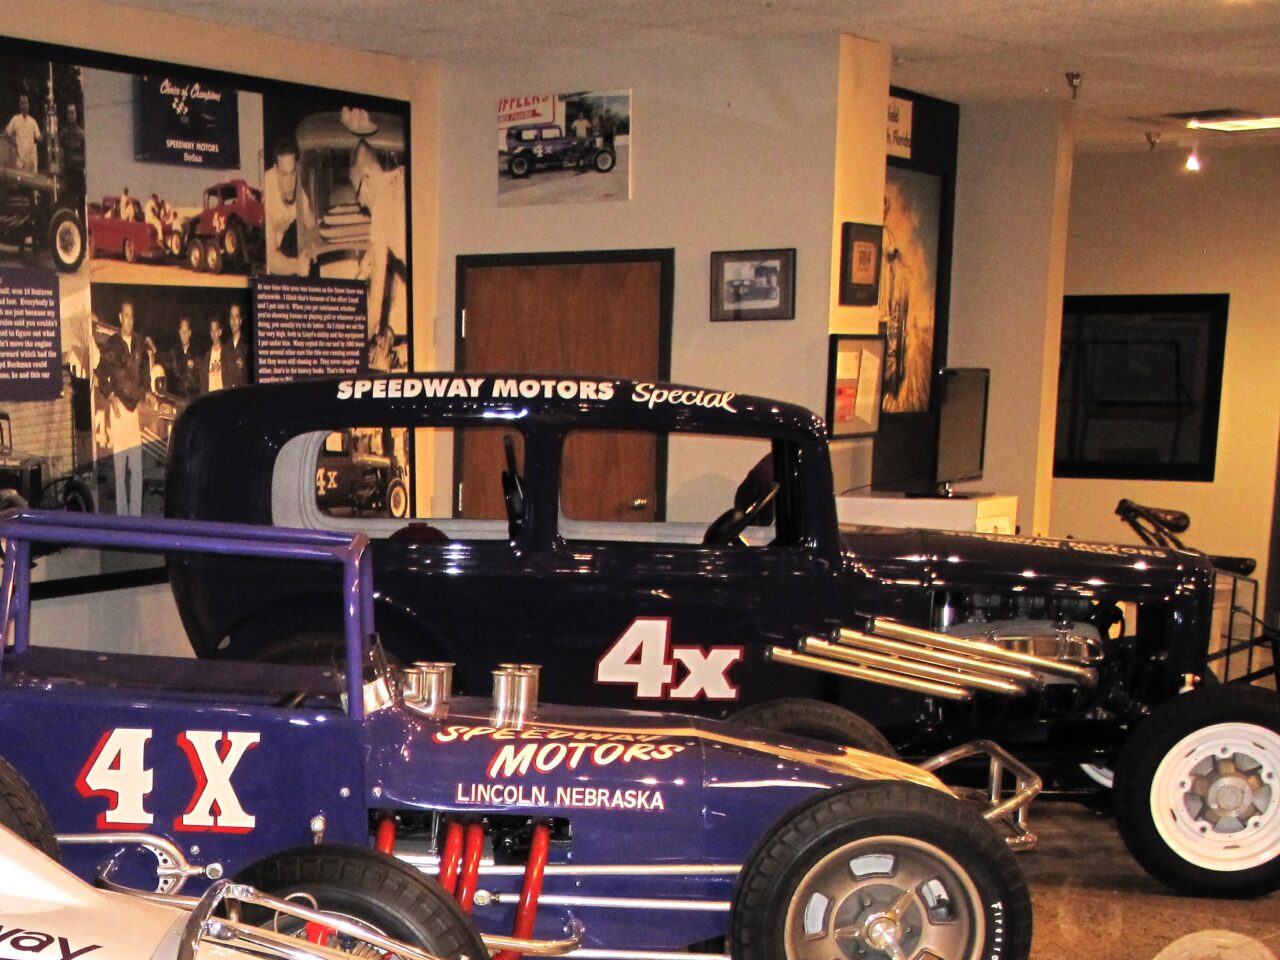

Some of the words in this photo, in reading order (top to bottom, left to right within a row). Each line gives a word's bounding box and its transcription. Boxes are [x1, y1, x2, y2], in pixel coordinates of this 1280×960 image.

[166, 139, 195, 150] SPEEDWAY
[196, 141, 219, 153] MOTORS
[183, 152, 203, 163] Sedan
[337, 379, 485, 399] SPEEDWAY
[492, 379, 615, 400] MOTORS
[432, 725, 663, 744] SPEEDWAY
[487, 742, 686, 779] MOTORS
[555, 786, 664, 810] NEBRASKA
